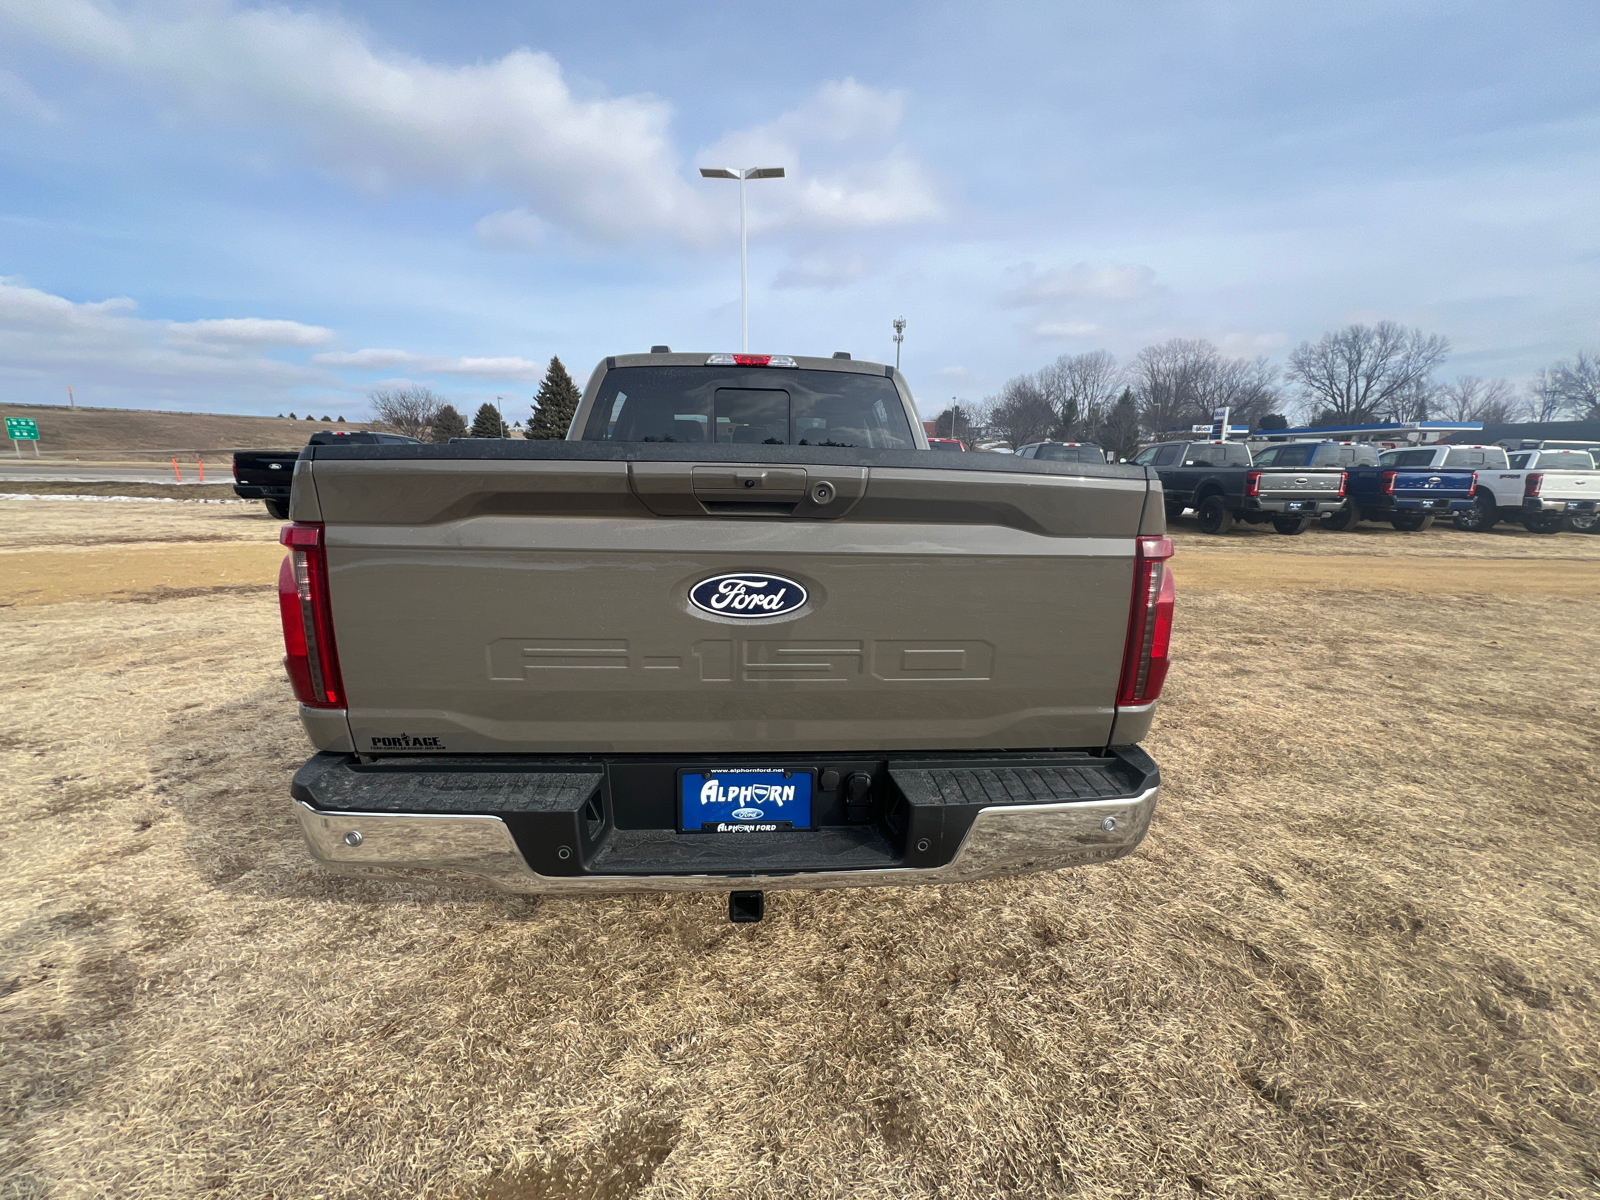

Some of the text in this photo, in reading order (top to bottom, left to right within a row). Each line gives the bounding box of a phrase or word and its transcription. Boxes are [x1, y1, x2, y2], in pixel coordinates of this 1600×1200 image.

[710, 579, 787, 610] Ford
[486, 638, 995, 681] F-150
[371, 736, 442, 746] PORTAGE
[738, 810, 758, 818] Ford
